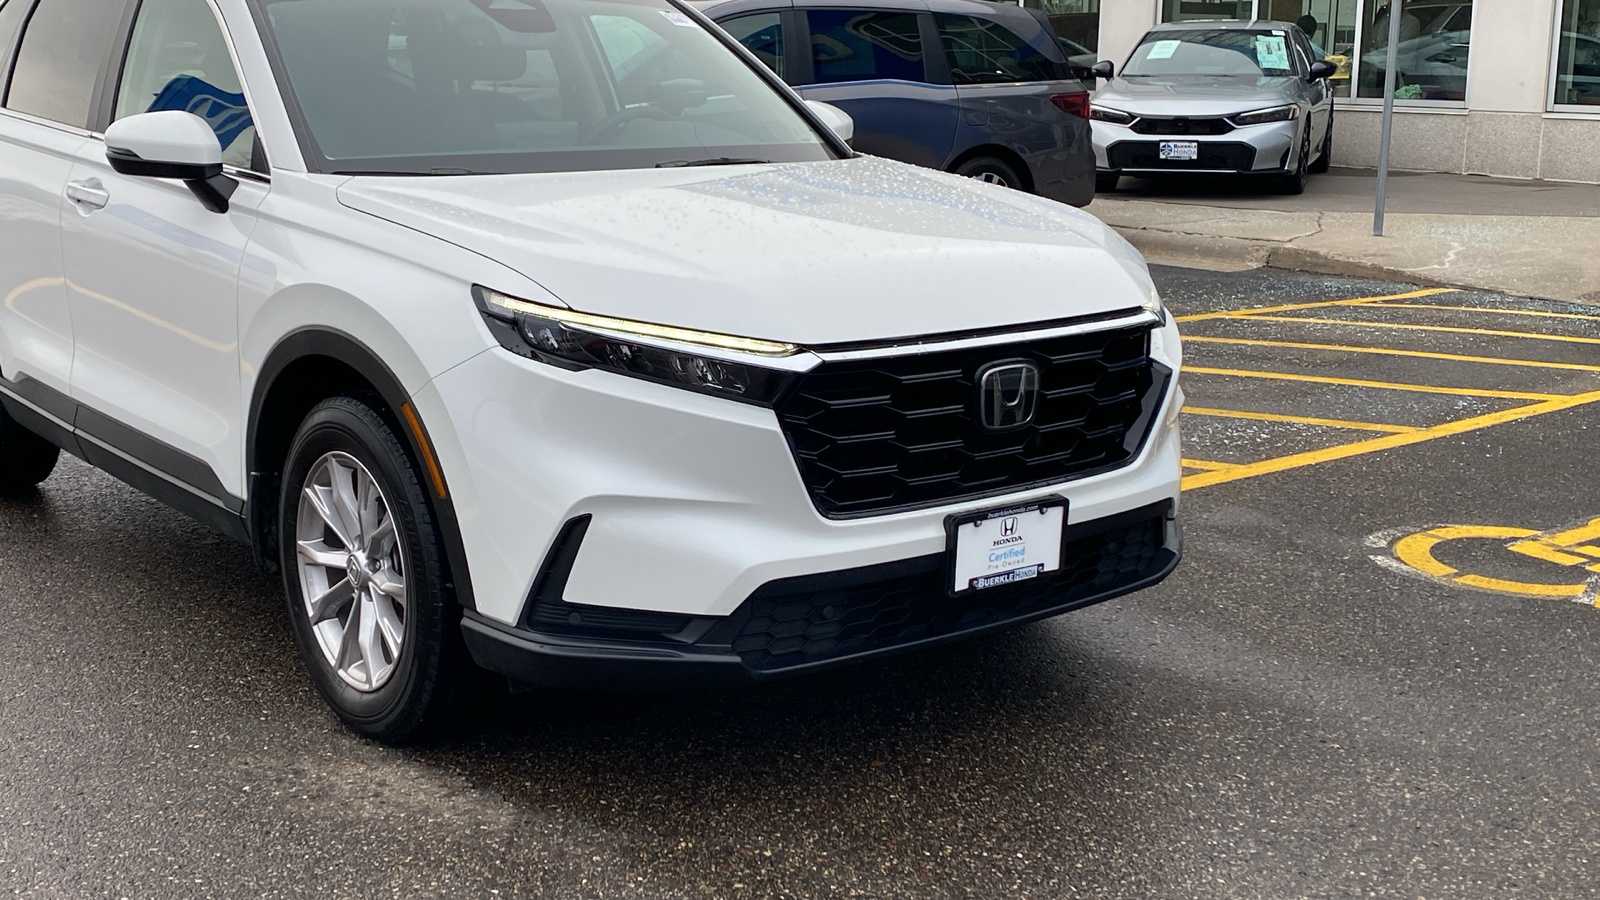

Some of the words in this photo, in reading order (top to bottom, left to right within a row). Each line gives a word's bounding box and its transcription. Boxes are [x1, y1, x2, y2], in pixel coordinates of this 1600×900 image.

[992, 536, 1023, 546] HONDA
[988, 546, 1026, 562] Certified
[988, 557, 1025, 570] Pre-Owned
[978, 573, 1015, 588] BUERKLE
[1015, 569, 1036, 579] HONDA
